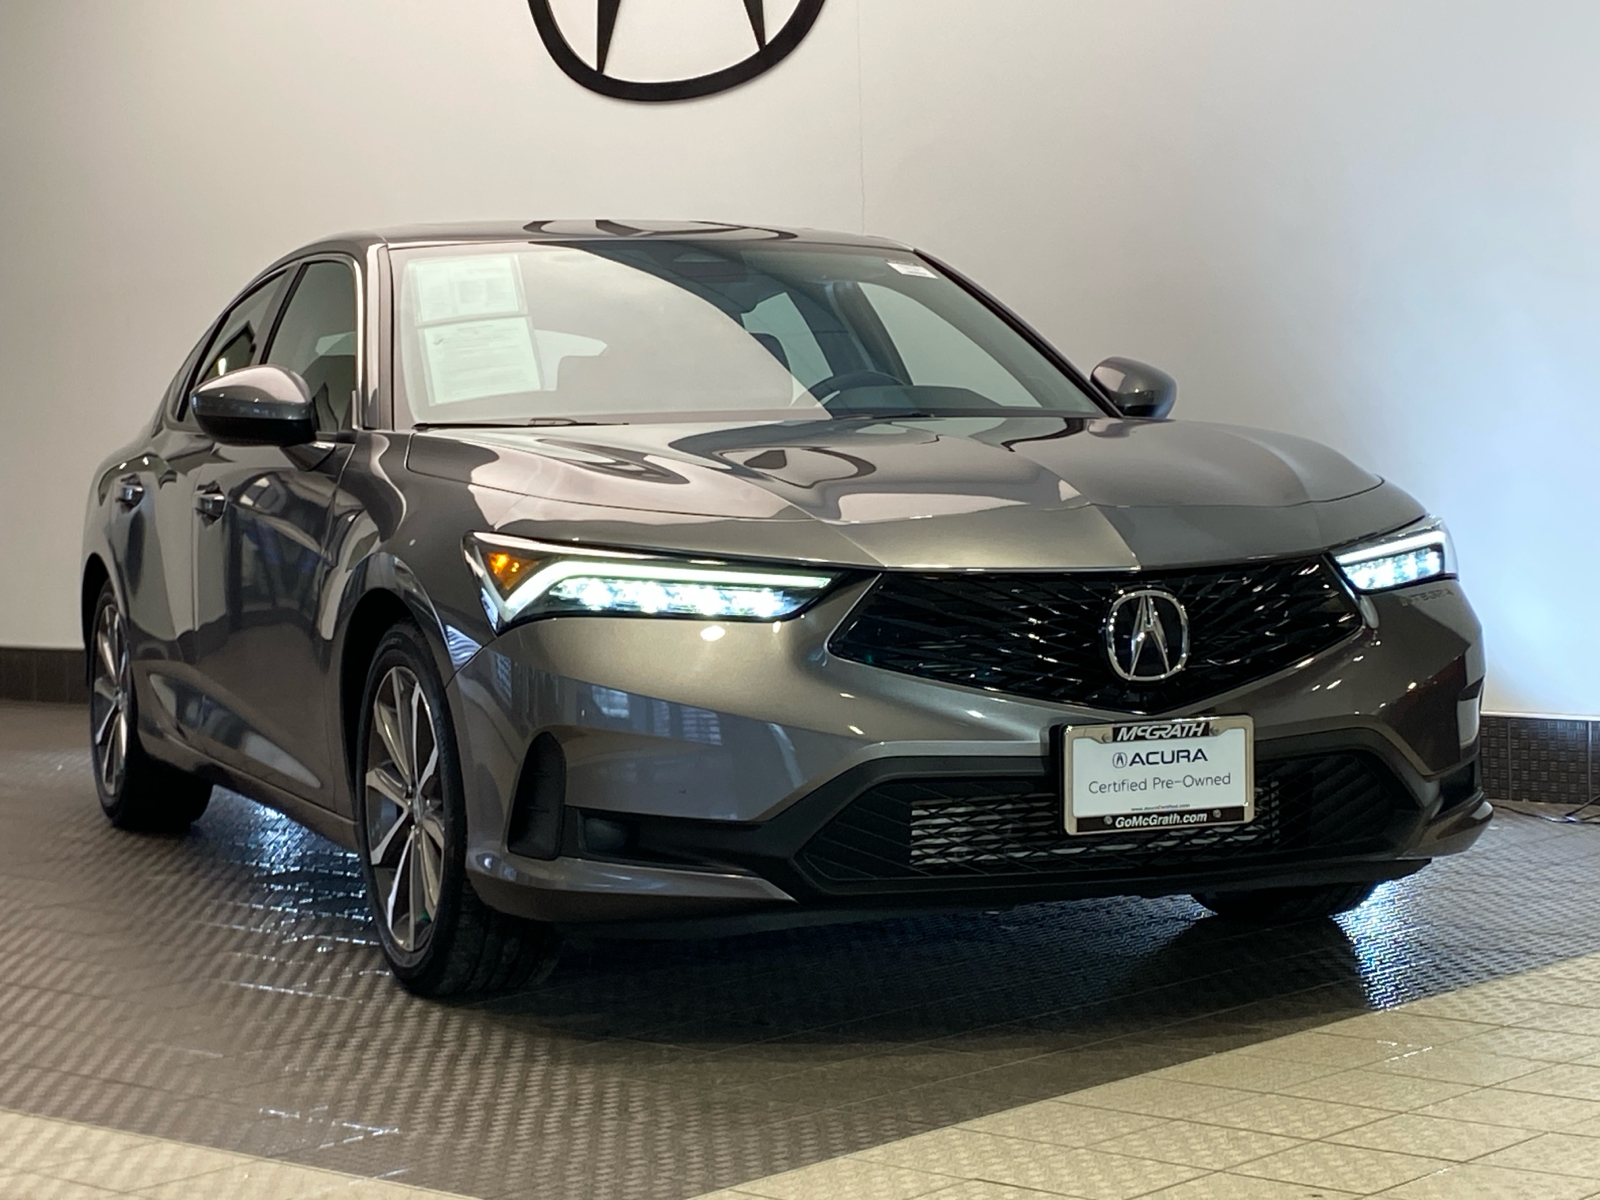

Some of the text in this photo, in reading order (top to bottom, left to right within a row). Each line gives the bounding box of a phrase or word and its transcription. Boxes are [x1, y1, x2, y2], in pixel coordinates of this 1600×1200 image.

[1128, 748, 1208, 767] ACURA
[1088, 772, 1231, 794] Certified Pre-Owned
[1115, 812, 1208, 828] GoMcGrath.com
